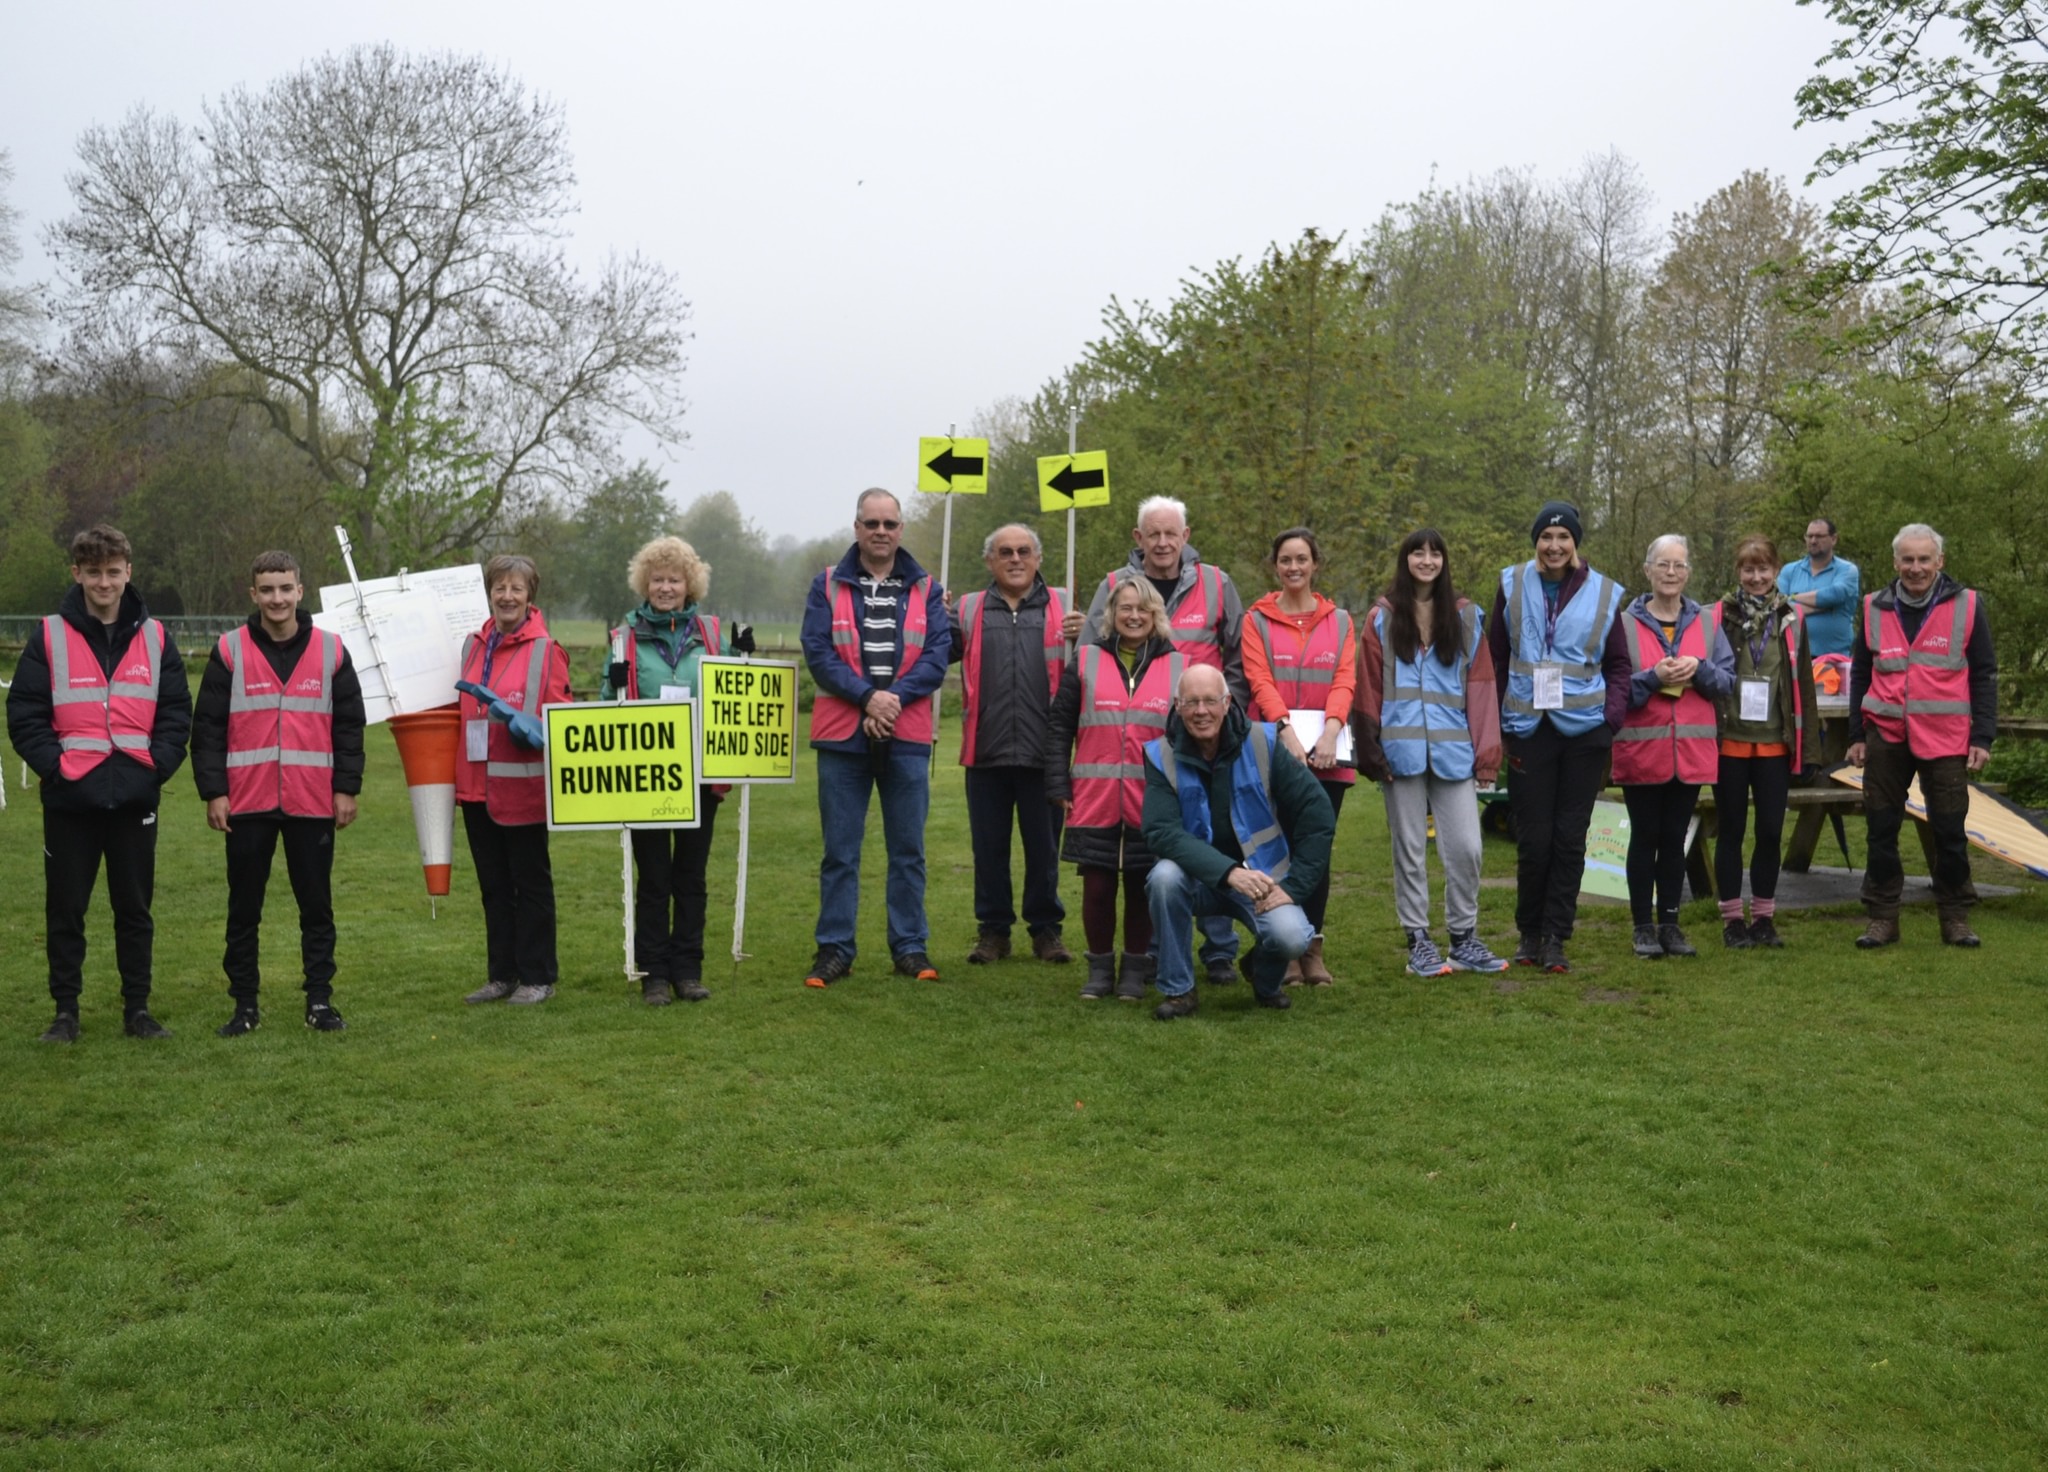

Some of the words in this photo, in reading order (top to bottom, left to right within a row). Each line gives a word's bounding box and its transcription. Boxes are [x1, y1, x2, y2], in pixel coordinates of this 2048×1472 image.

[714, 670, 754, 696] KEEP
[760, 673, 783, 698] ON
[711, 700, 741, 726] THE
[748, 703, 785, 728] LEFT
[564, 721, 675, 753] CAUTION
[706, 730, 749, 756] HAND
[754, 732, 790, 757] SIDE
[560, 763, 683, 795] RUNNERS
